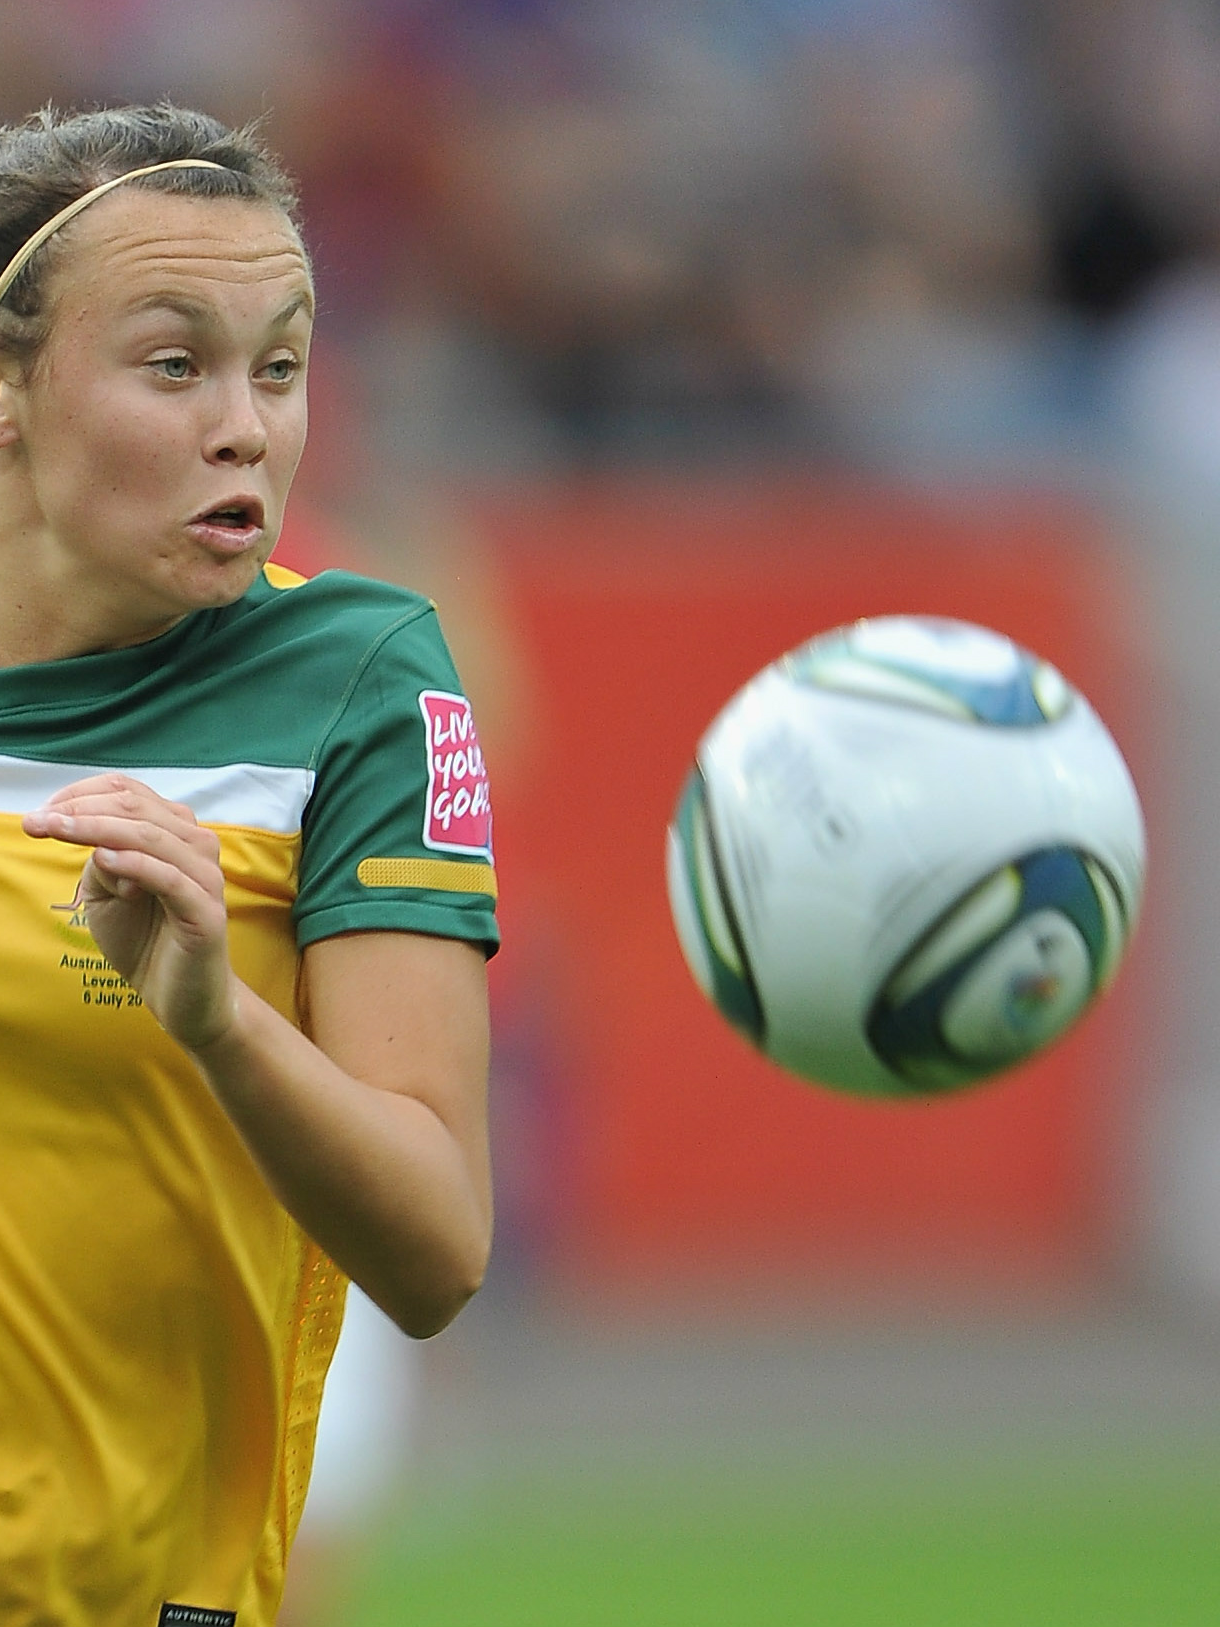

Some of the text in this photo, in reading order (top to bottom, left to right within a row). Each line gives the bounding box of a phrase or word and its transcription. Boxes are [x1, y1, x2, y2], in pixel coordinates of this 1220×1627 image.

[433, 781, 491, 831] GOA
[59, 953, 115, 971] Australi
[82, 972, 132, 988] Leverk
[83, 989, 143, 1009] 6 July 20
[165, 1609, 232, 1626] AUTHENTIC
